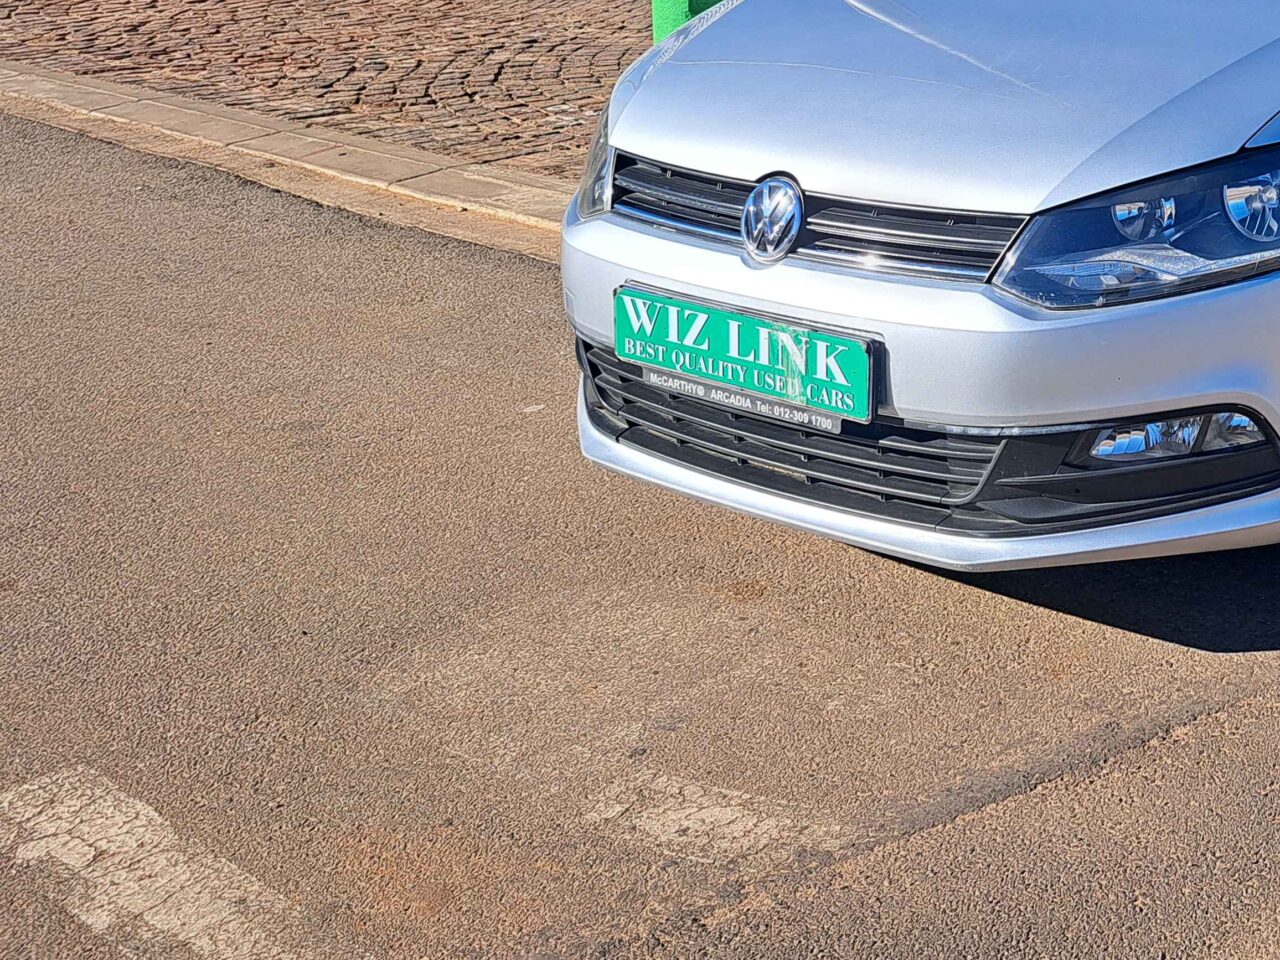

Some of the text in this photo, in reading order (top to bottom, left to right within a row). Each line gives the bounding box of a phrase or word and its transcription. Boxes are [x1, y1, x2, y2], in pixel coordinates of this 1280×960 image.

[619, 293, 852, 387] WIZ LINK
[624, 336, 855, 411] BEST QUALITY USED CARS
[710, 389, 752, 410] ARCADIA
[755, 399, 773, 415] Tel:
[773, 403, 809, 424] 012-309
[811, 414, 833, 430] 1700
